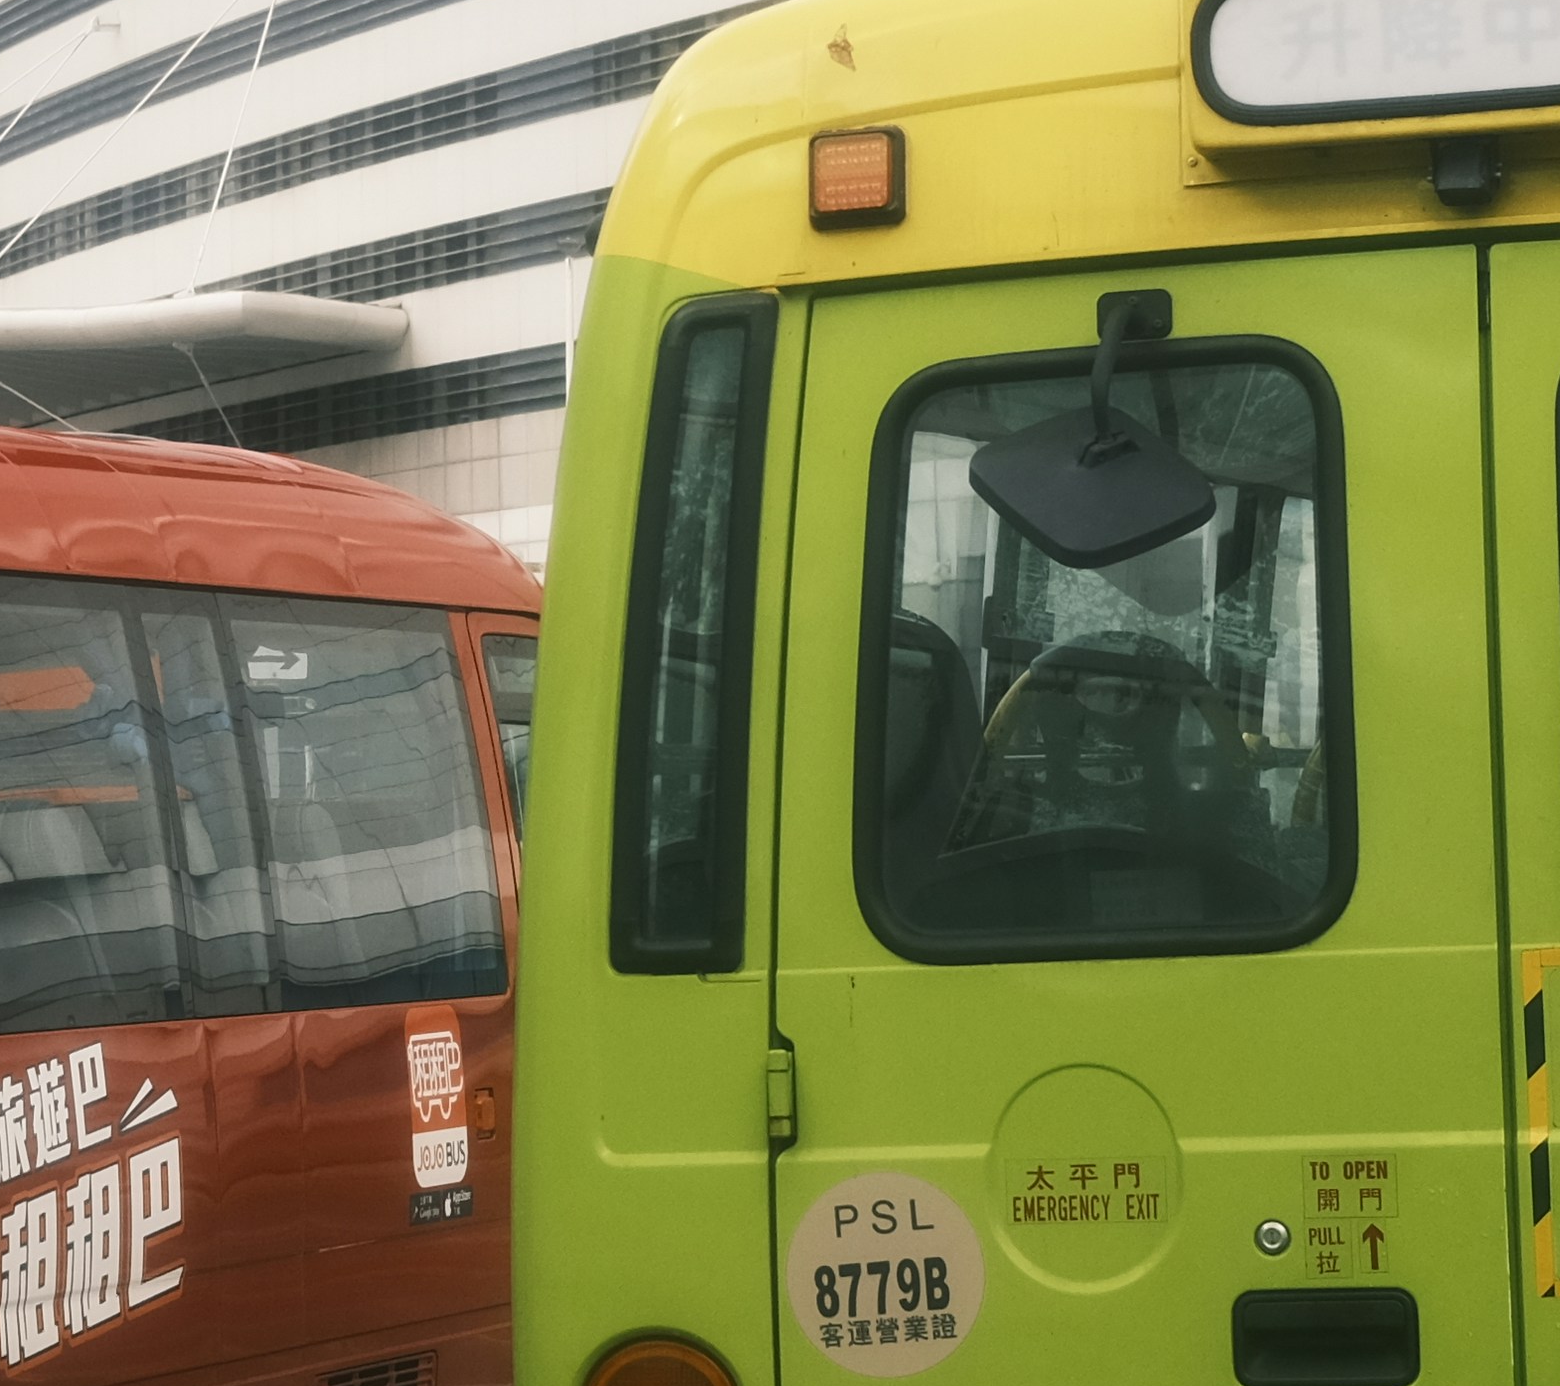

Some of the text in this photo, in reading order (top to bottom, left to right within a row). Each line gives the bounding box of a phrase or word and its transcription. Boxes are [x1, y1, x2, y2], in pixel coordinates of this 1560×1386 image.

[417, 1140, 466, 1172] JOJO BUS
[1309, 1160, 1388, 1181] TO OPEN
[1026, 1162, 1141, 1191] 太平門
[1012, 1193, 1160, 1222] EMERGENCY EXIT
[1317, 1188, 1382, 1212] 開門
[834, 1198, 935, 1238] PSL
[1308, 1226, 1345, 1246] PULL
[1316, 1251, 1341, 1274] 拉
[814, 1256, 951, 1319] 8779B
[819, 1313, 958, 1349] 客運營業證
